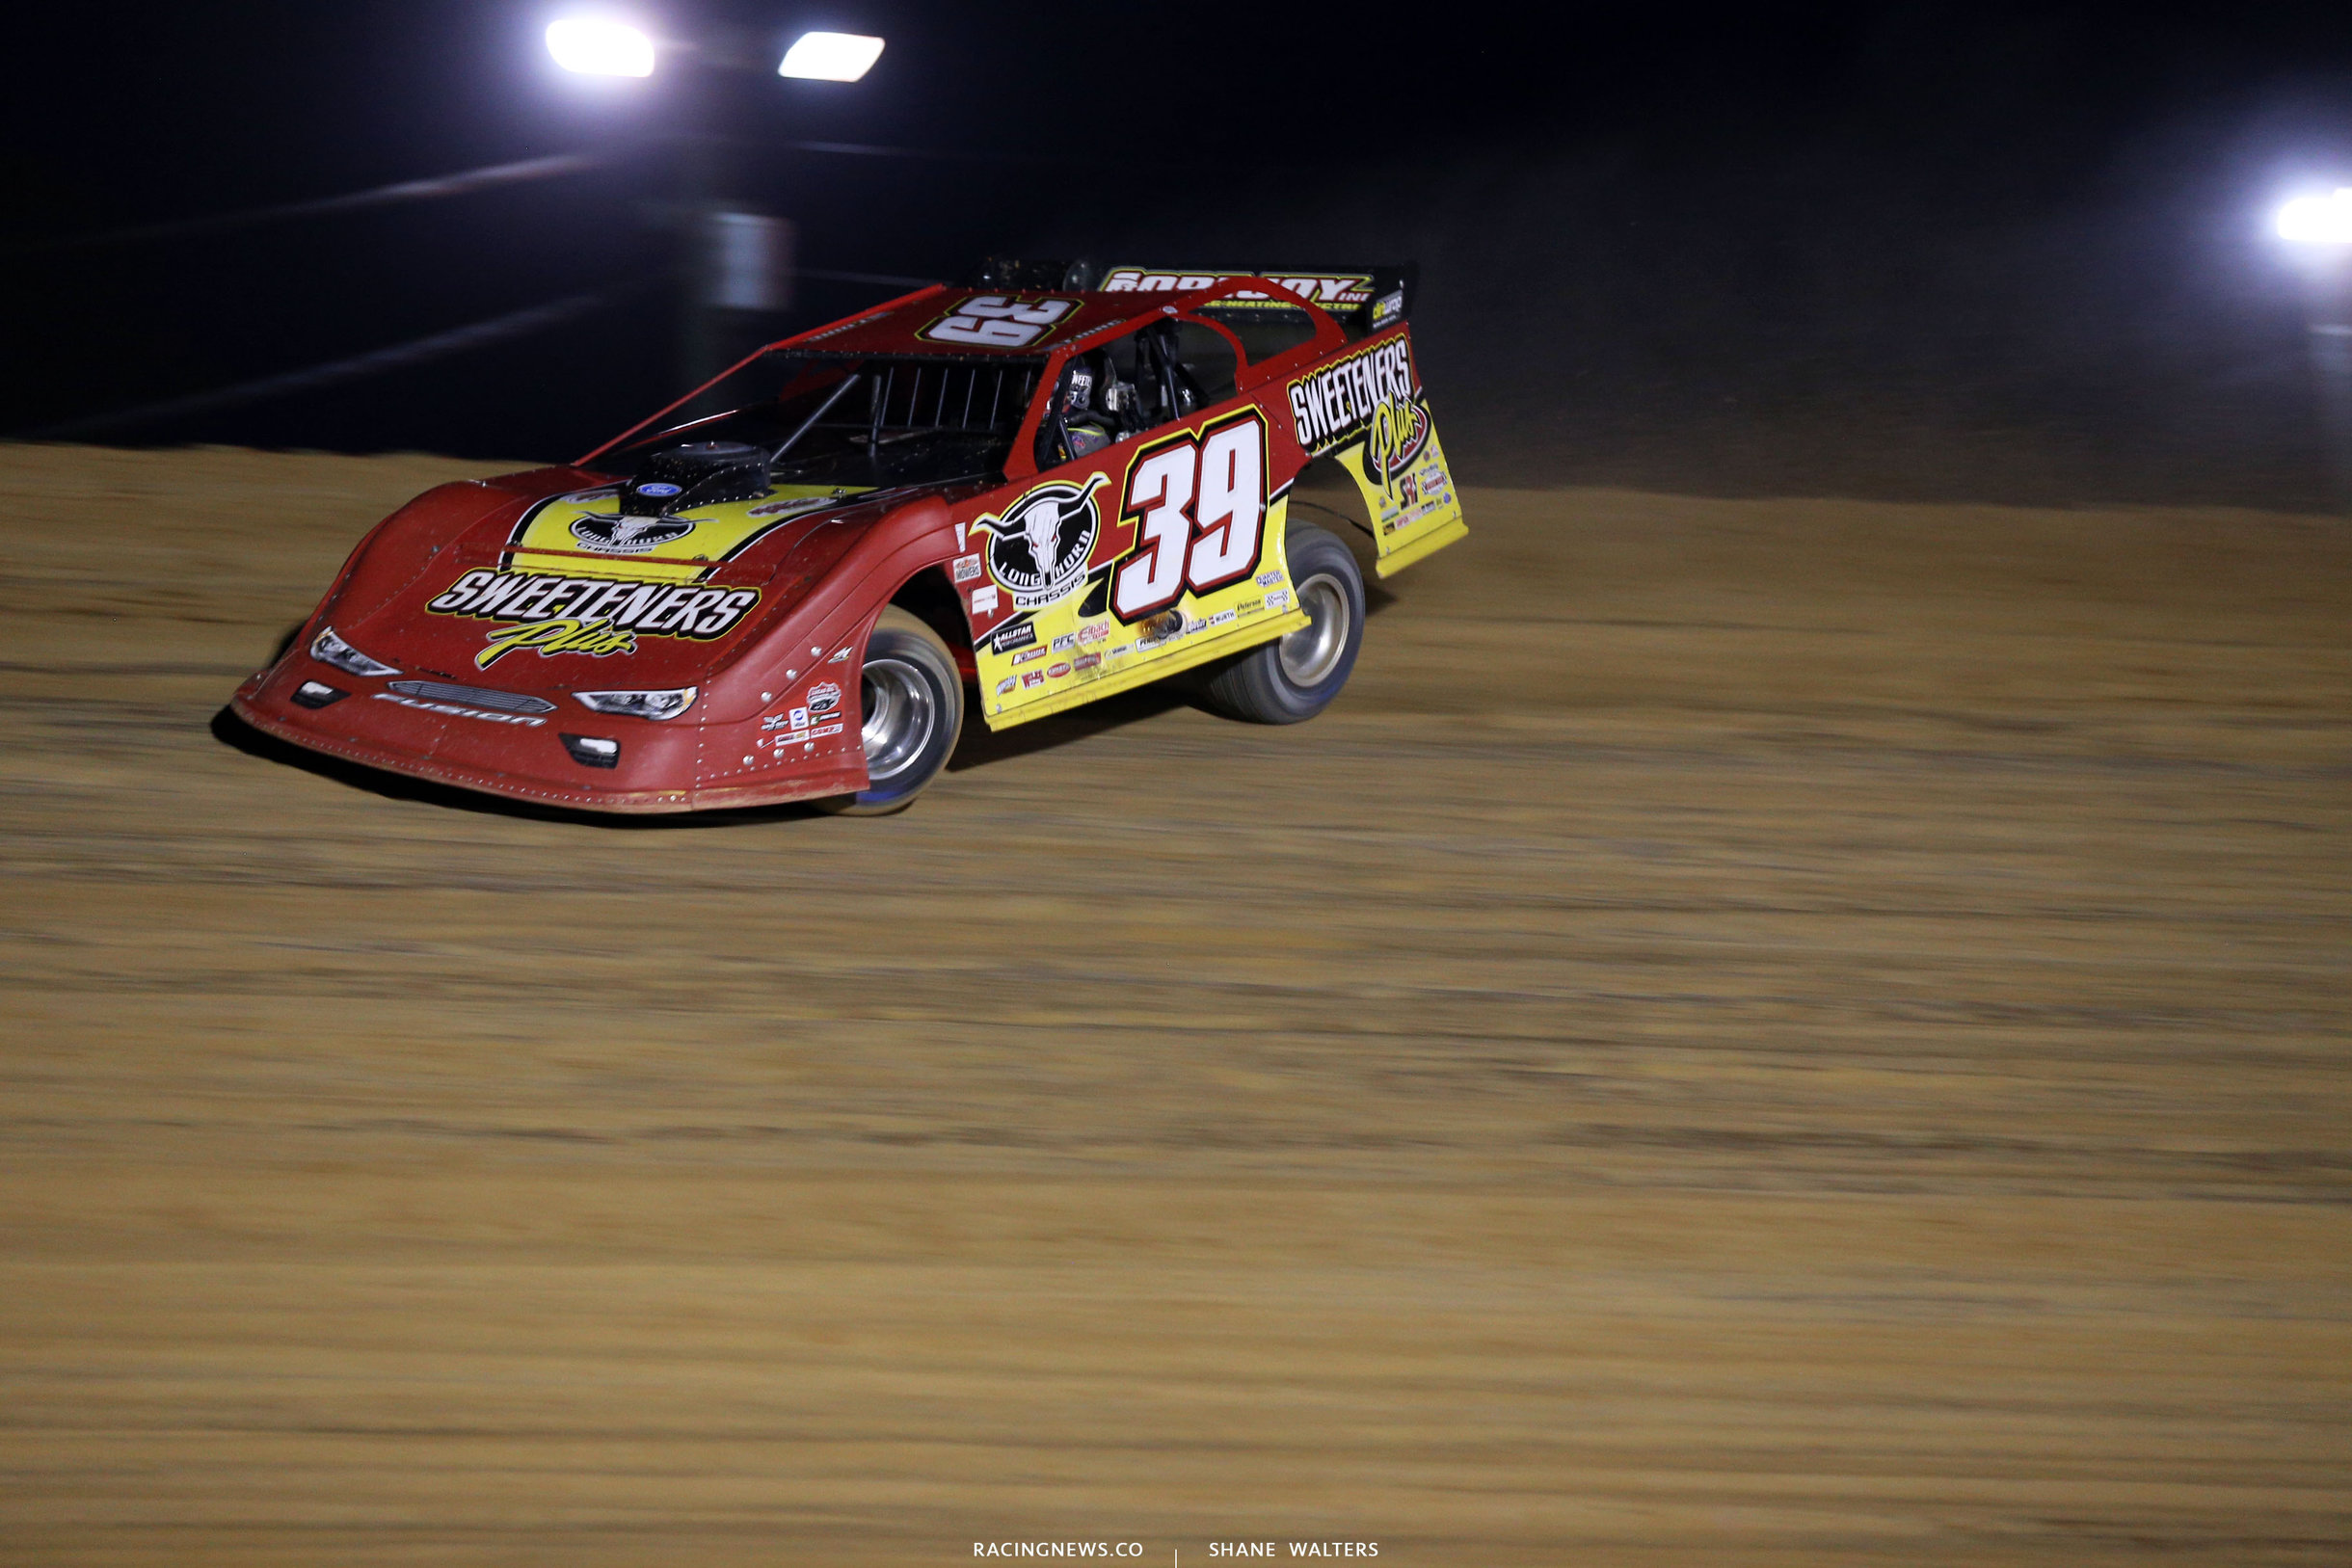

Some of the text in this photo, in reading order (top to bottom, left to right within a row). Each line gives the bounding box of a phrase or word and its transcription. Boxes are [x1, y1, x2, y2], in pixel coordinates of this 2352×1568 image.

[927, 295, 1072, 348] 39
[1289, 337, 1412, 447] SWEETENERS
[1371, 389, 1420, 502] Plus
[1115, 418, 1262, 616] 39
[431, 570, 757, 635] SWEETENERS
[1015, 570, 1086, 607] CHASSIS
[475, 618, 637, 672] Plus
[1000, 624, 1032, 641] ALLSTAR
[1053, 632, 1075, 651] PFC
